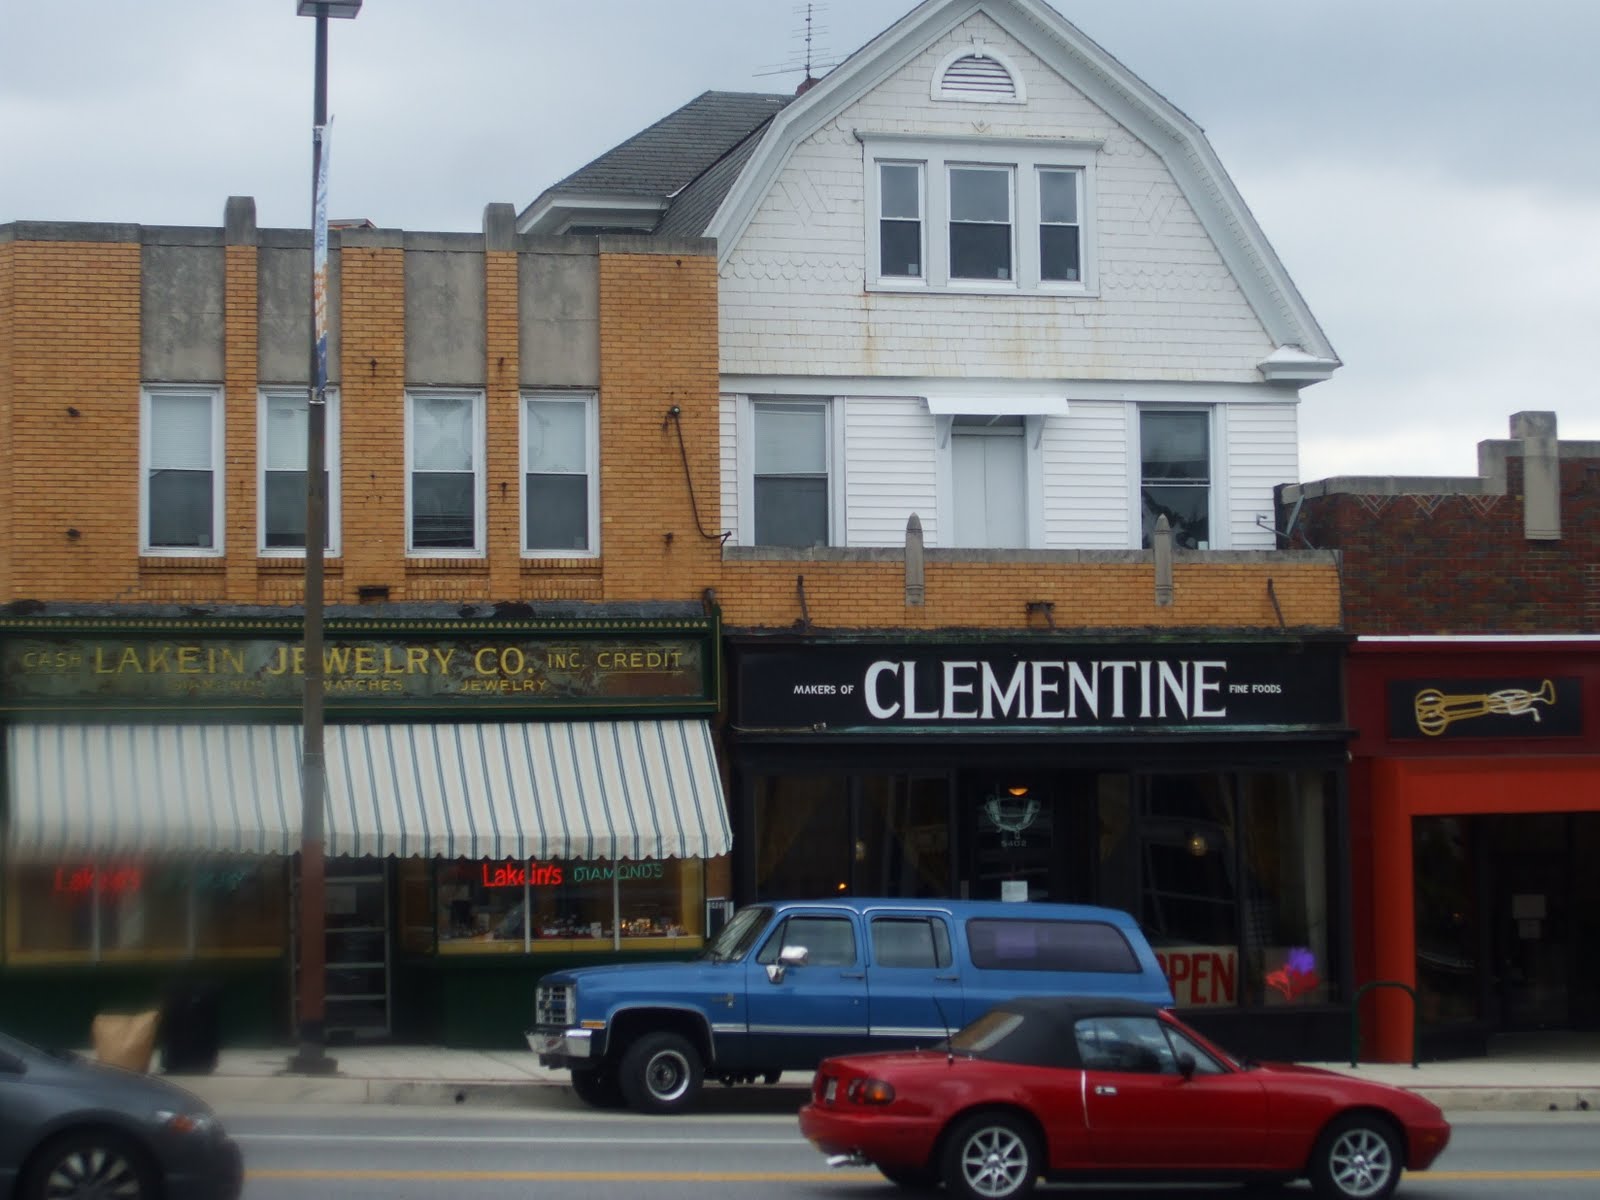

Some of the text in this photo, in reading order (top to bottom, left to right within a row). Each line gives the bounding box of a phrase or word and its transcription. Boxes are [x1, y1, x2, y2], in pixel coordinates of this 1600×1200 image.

[95, 646, 246, 674] LAKEIN
[266, 646, 454, 675] JEWELRY
[474, 646, 535, 675] CO.
[548, 652, 586, 669] INC.
[597, 652, 683, 668] CREDIT
[461, 679, 548, 692] JEWELRY
[793, 684, 855, 696] MAKERS OF
[864, 660, 1227, 720] CLEMENTINE
[1229, 684, 1282, 694] FINE FOODS
